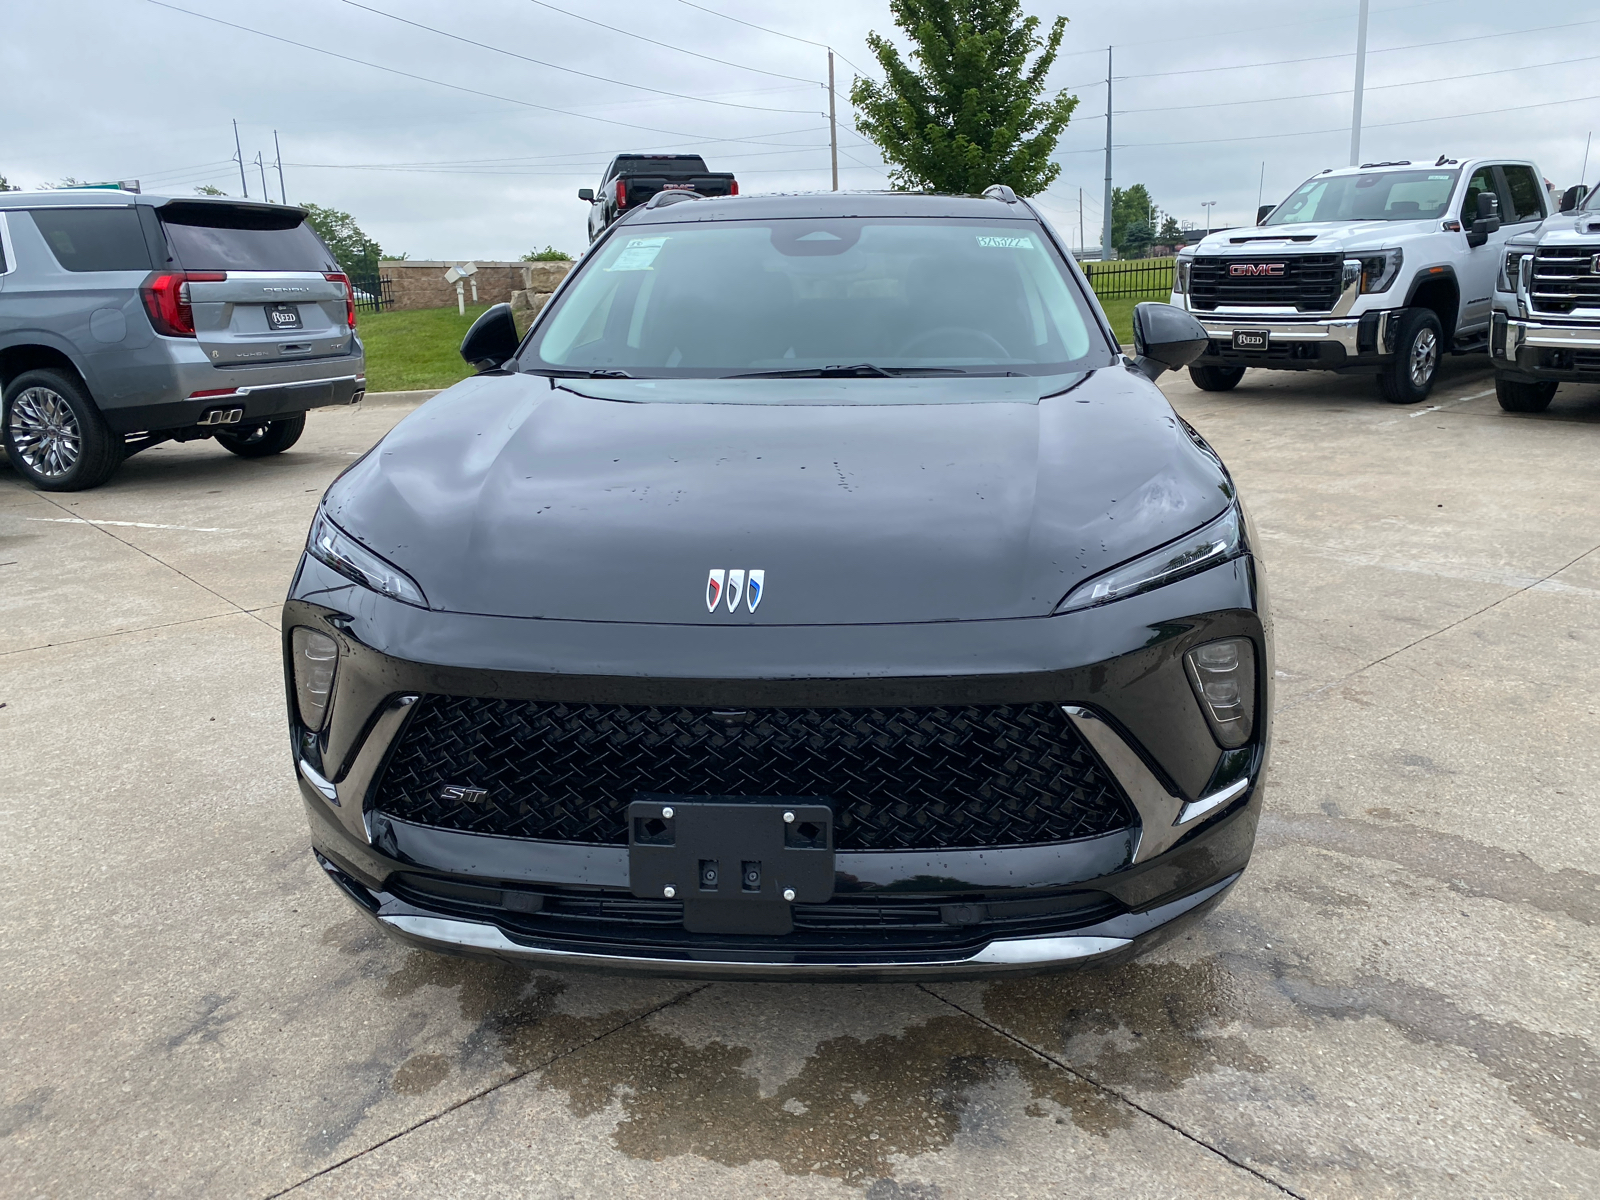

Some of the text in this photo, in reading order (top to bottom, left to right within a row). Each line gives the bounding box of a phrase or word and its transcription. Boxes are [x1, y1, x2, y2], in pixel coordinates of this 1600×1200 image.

[663, 183, 695, 191] GMC
[1229, 263, 1285, 276] GMC
[271, 311, 296, 325] REED
[1237, 333, 1263, 346] REED
[440, 785, 488, 803] ST
